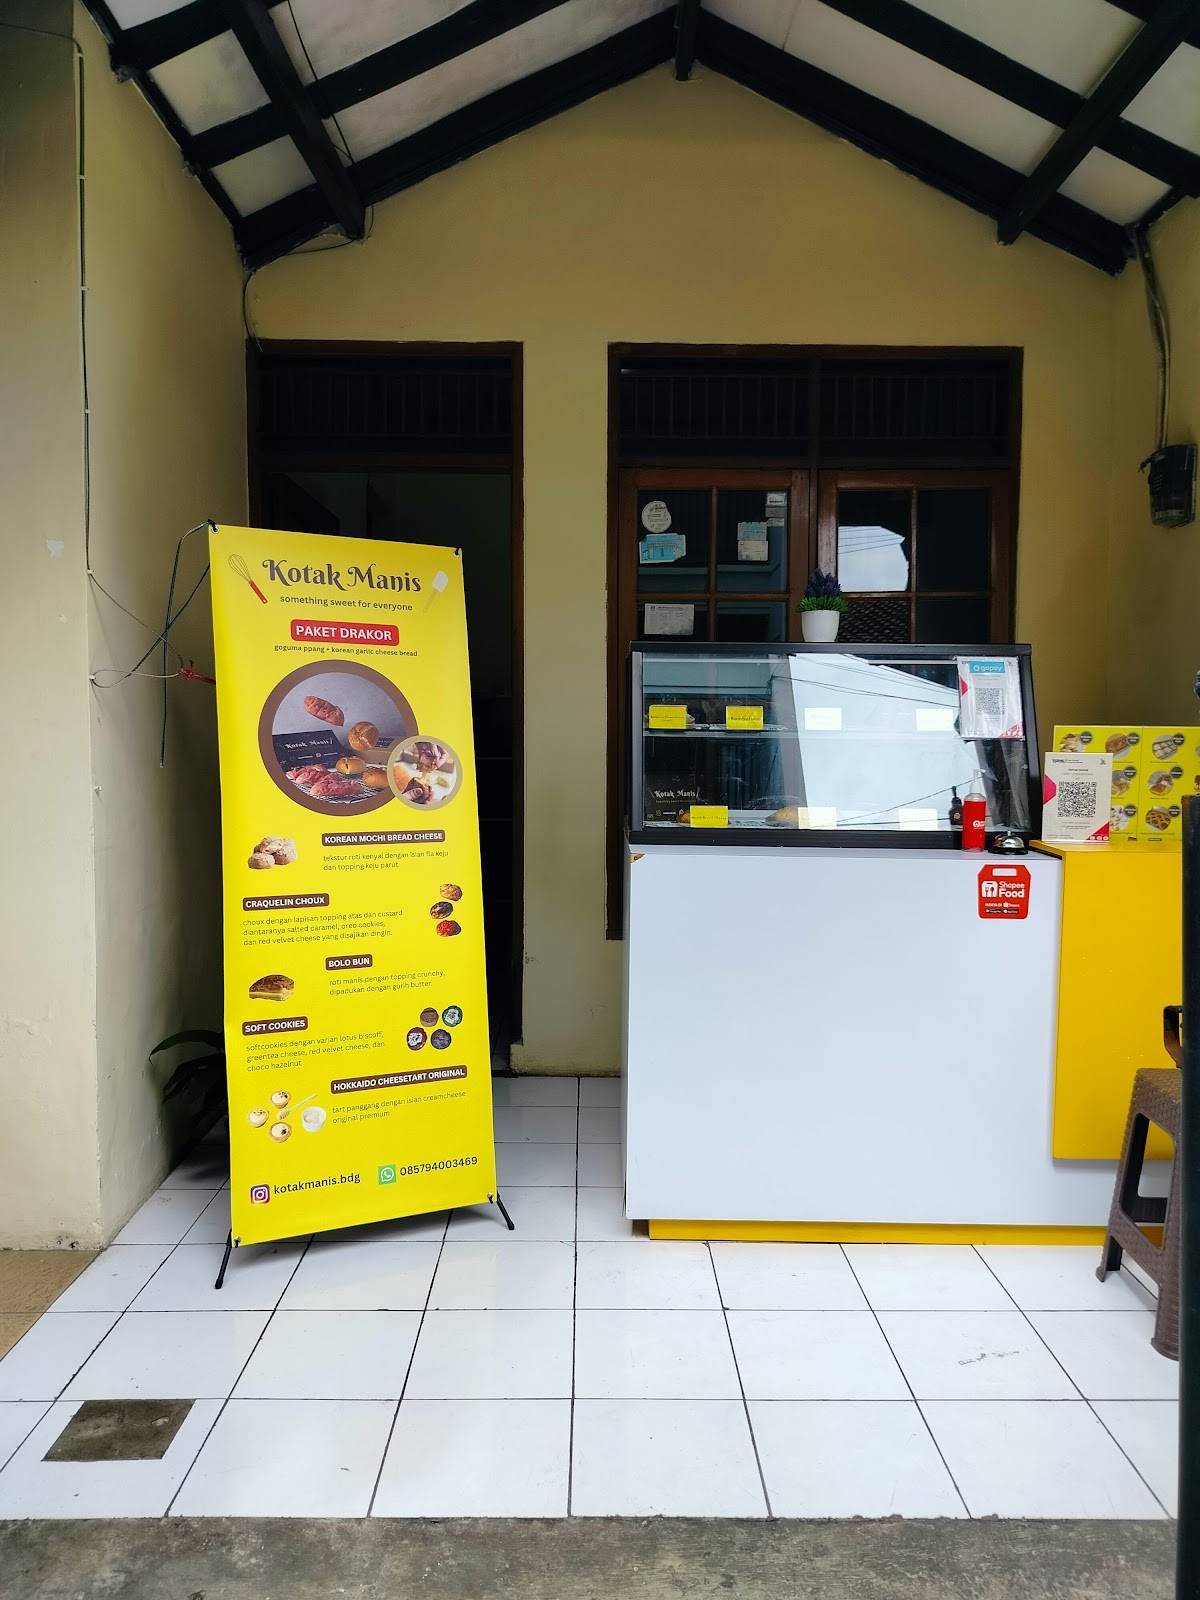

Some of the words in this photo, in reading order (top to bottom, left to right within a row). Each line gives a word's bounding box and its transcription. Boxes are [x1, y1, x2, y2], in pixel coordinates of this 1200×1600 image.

[262, 559, 348, 591] Kotak
[348, 564, 421, 592] Manis
[280, 595, 328, 607] something
[330, 598, 356, 608] sweet
[358, 600, 371, 608] for
[373, 602, 412, 611] everyone
[296, 625, 337, 637] PAKET
[340, 628, 392, 641] DRAKOR
[325, 835, 357, 844] KOREAN
[359, 834, 386, 842] MOCHI
[387, 833, 412, 841] BREAD
[414, 832, 442, 840] CHEESE
[338, 863, 364, 871] topping
[999, 881, 1024, 890] Shopee
[999, 889, 1024, 897] Food
[246, 898, 293, 908] CRAQUELIN
[295, 897, 325, 905] CHOUX
[243, 918, 264, 926] choux
[266, 916, 292, 926] dengan
[294, 914, 318, 924] lapisan
[320, 913, 346, 923] topping
[348, 911, 362, 919] atas
[364, 910, 376, 918] dan
[378, 909, 402, 917] custard
[244, 926, 285, 937] diantaranya
[287, 925, 308, 933] salted
[310, 924, 339, 932] caramel,
[273, 935, 294, 943] velvet
[296, 933, 320, 941] cheese
[322, 933, 338, 941] yang
[340, 930, 369, 940] disajikan
[371, 930, 392, 938] dingin.
[329, 959, 351, 967] BOLO
[352, 958, 370, 966] BUN
[343, 976, 363, 984] manis
[365, 974, 389, 984] dengan
[391, 972, 416, 981] topping
[418, 970, 445, 979] crunchy,
[330, 986, 365, 996] dipadukan
[366, 985, 391, 994] dengan
[392, 982, 409, 991] gurih
[245, 1024, 266, 1032] SOFT
[268, 1020, 305, 1030] COOKIES
[246, 1042, 287, 1051] softcookies
[289, 1039, 315, 1048] dengan
[340, 1034, 357, 1042] lotus
[359, 1032, 383, 1040] biscoff,
[247, 1052, 279, 1063] greentea
[281, 1050, 307, 1059] cheese,
[309, 1047, 320, 1055] red
[322, 1045, 343, 1054] velvet
[248, 1063, 269, 1071] choco
[271, 1060, 301, 1069] hazelnut
[334, 1079, 376, 1091] HOKKAIDO
[378, 1073, 427, 1085] CHEESETART
[428, 1068, 465, 1080] ORIGINAL
[332, 1105, 345, 1113] tart
[346, 1102, 380, 1112] panggang
[381, 1098, 405, 1108] dengan
[407, 1096, 421, 1104] isian
[423, 1091, 466, 1102] creamcheese
[333, 1113, 358, 1124] original
[360, 1110, 389, 1119] premium
[400, 1157, 477, 1176] 085794003469
[274, 1173, 360, 1194] kotakmanis.bdg
